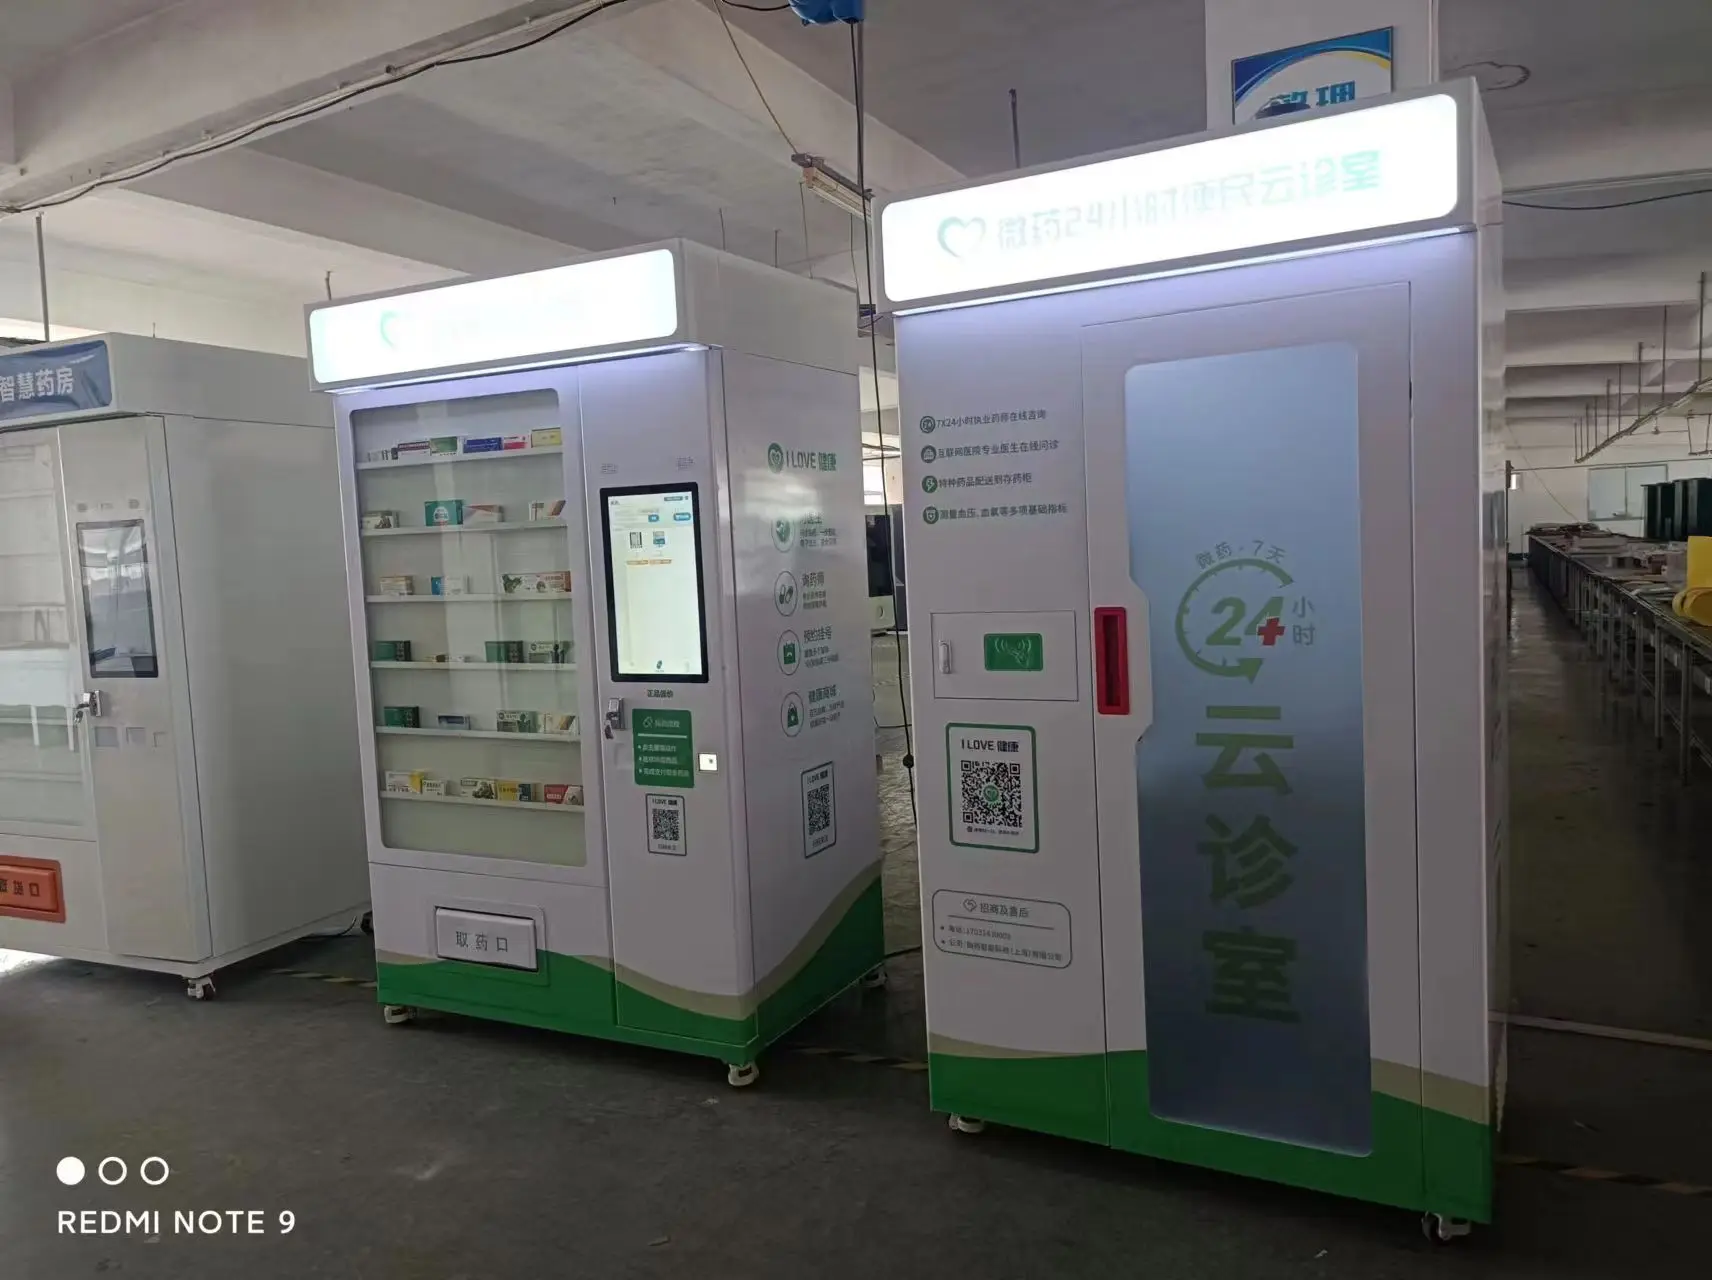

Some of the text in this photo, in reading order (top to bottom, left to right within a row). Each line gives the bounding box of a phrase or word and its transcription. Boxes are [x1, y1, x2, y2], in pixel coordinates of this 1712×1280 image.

[0, 366, 73, 402] 智慧药房
[791, 451, 816, 468] LOVE
[1205, 596, 1285, 646] 24
[1292, 596, 1316, 646] 小时
[967, 739, 994, 750] LOVE
[1195, 705, 1301, 1024] 云诊室
[456, 930, 508, 953] 取药口
